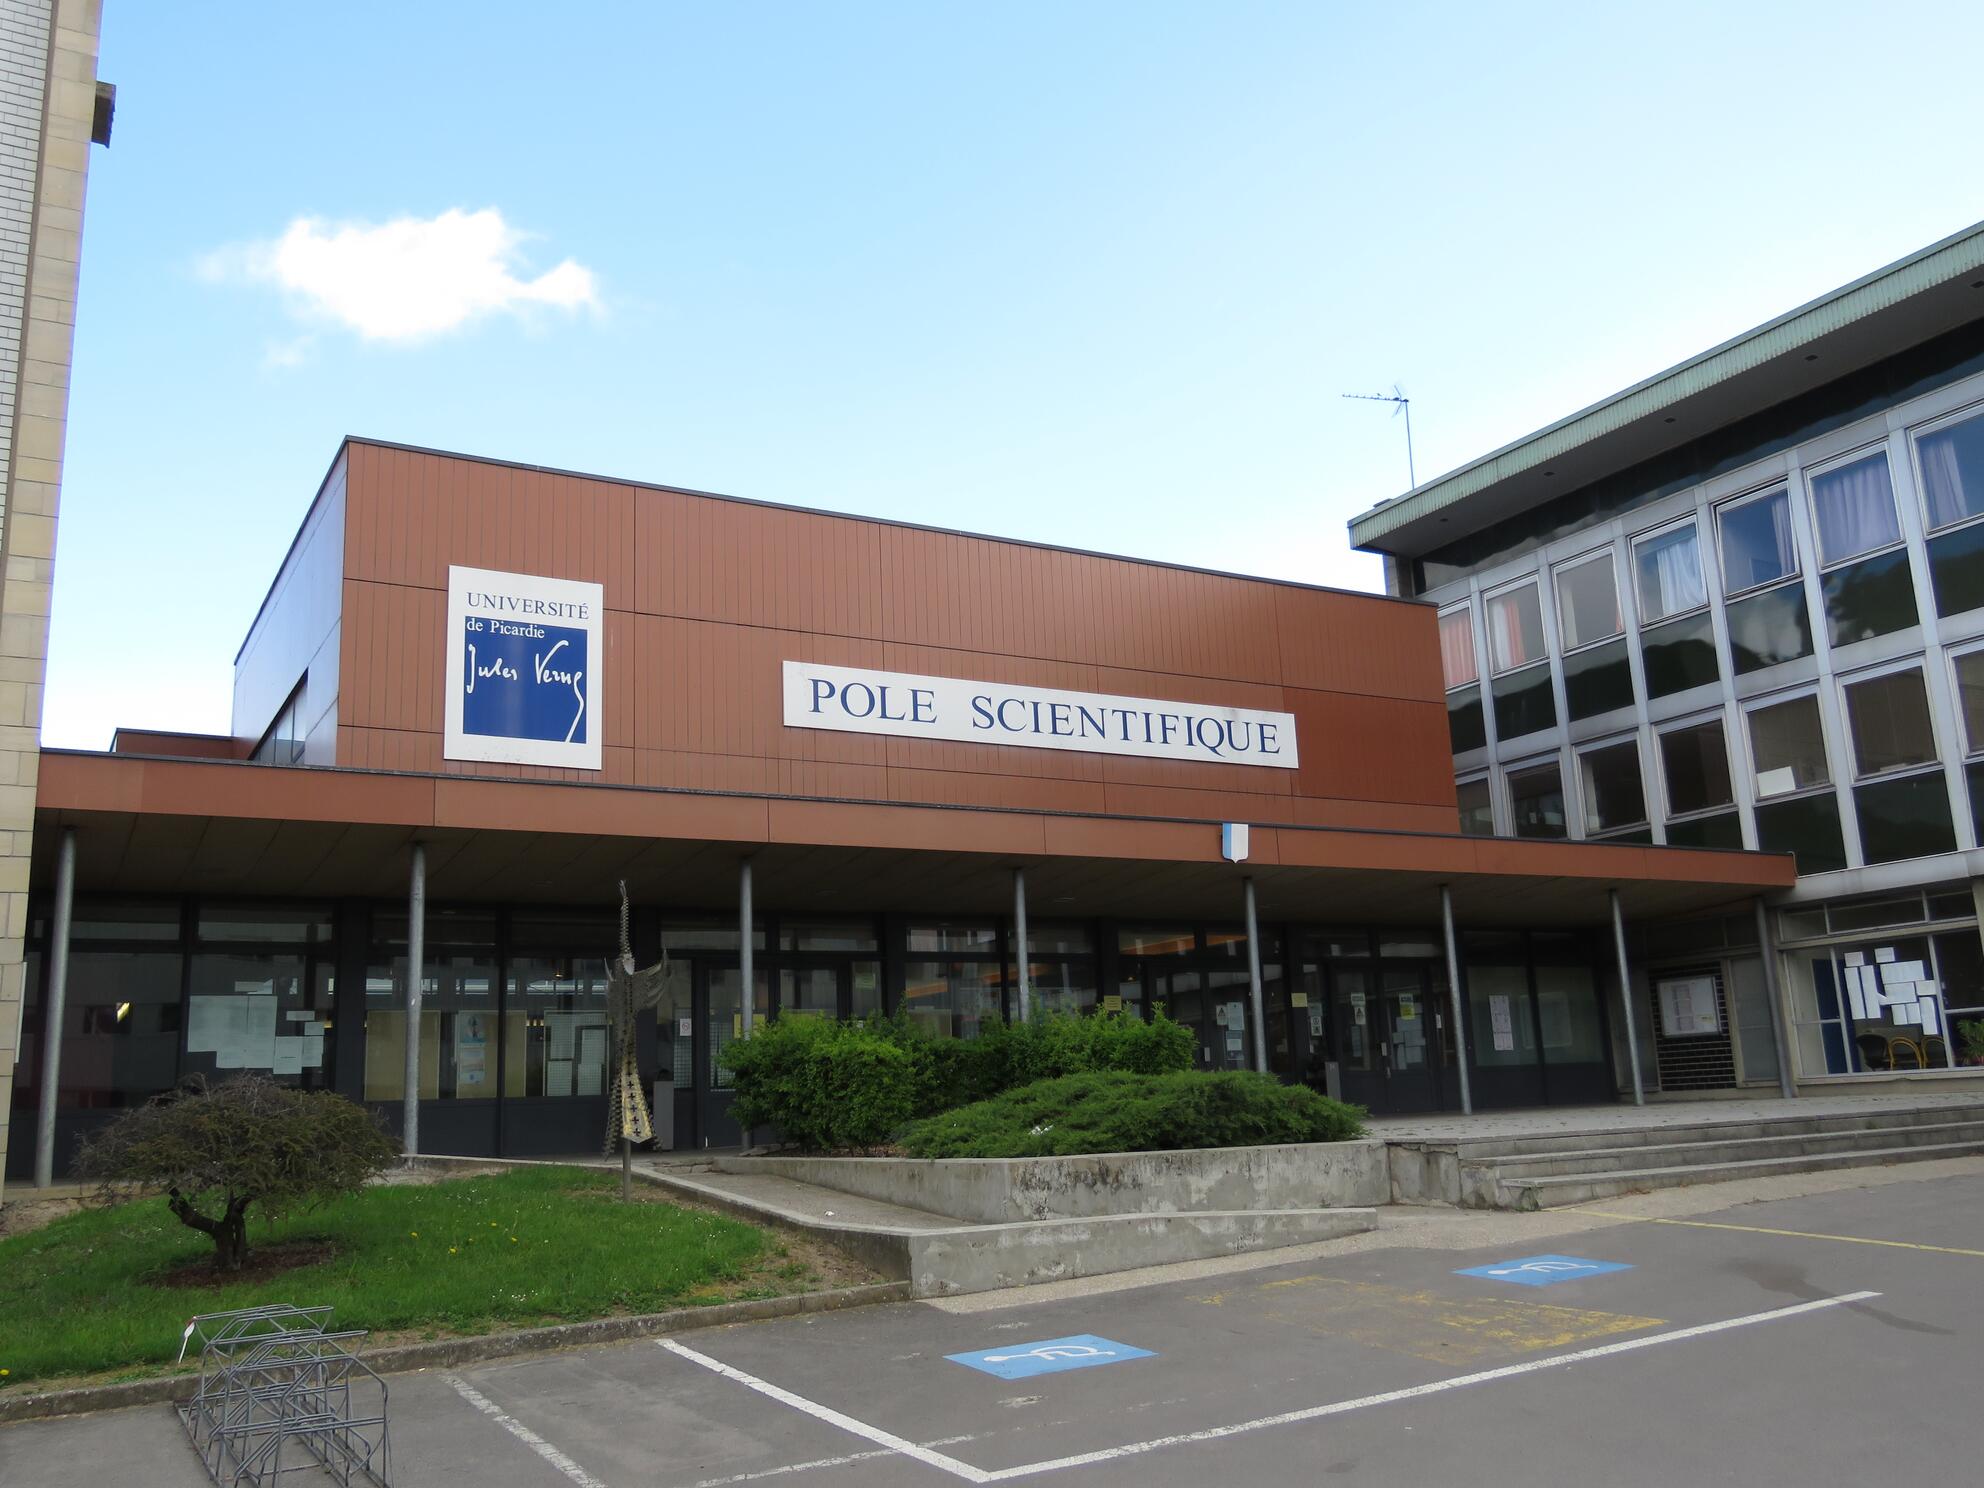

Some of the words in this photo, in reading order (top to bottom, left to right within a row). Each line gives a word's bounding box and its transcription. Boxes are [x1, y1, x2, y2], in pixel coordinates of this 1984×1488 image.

[466, 592, 590, 620] UNIVERSITÉ
[466, 617, 484, 632] de
[490, 620, 545, 639] Picardie
[466, 643, 518, 694] Jules
[808, 678, 938, 724] POLE
[972, 695, 1281, 758] SCIENTIFIQUE
